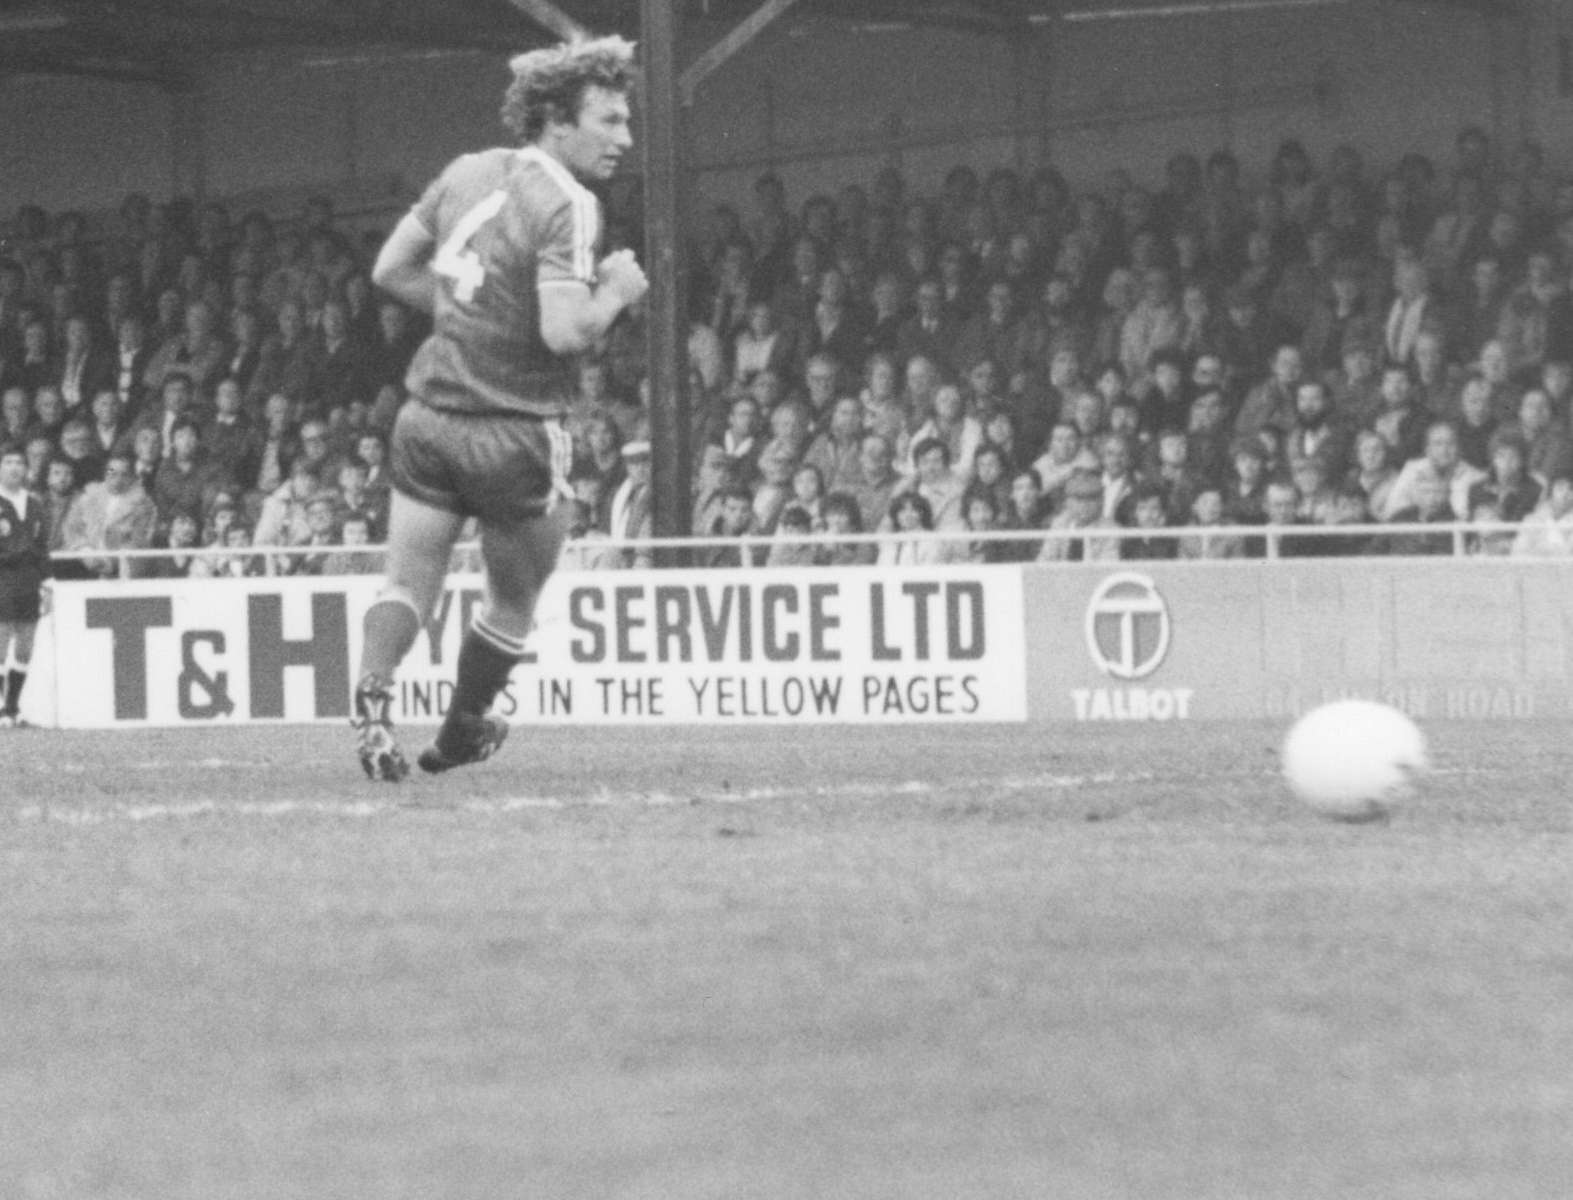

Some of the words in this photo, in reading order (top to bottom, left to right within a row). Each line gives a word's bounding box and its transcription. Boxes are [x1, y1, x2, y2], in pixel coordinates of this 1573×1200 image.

[432, 190, 508, 301] 4
[569, 583, 841, 663] SERVICE
[870, 581, 986, 661] LTD
[401, 680, 460, 717] IND
[539, 679, 572, 716] IN
[596, 678, 664, 716] THE
[688, 676, 842, 717] YELLOW
[864, 675, 980, 715] PAGES
[1072, 687, 1194, 721] TALBOT
